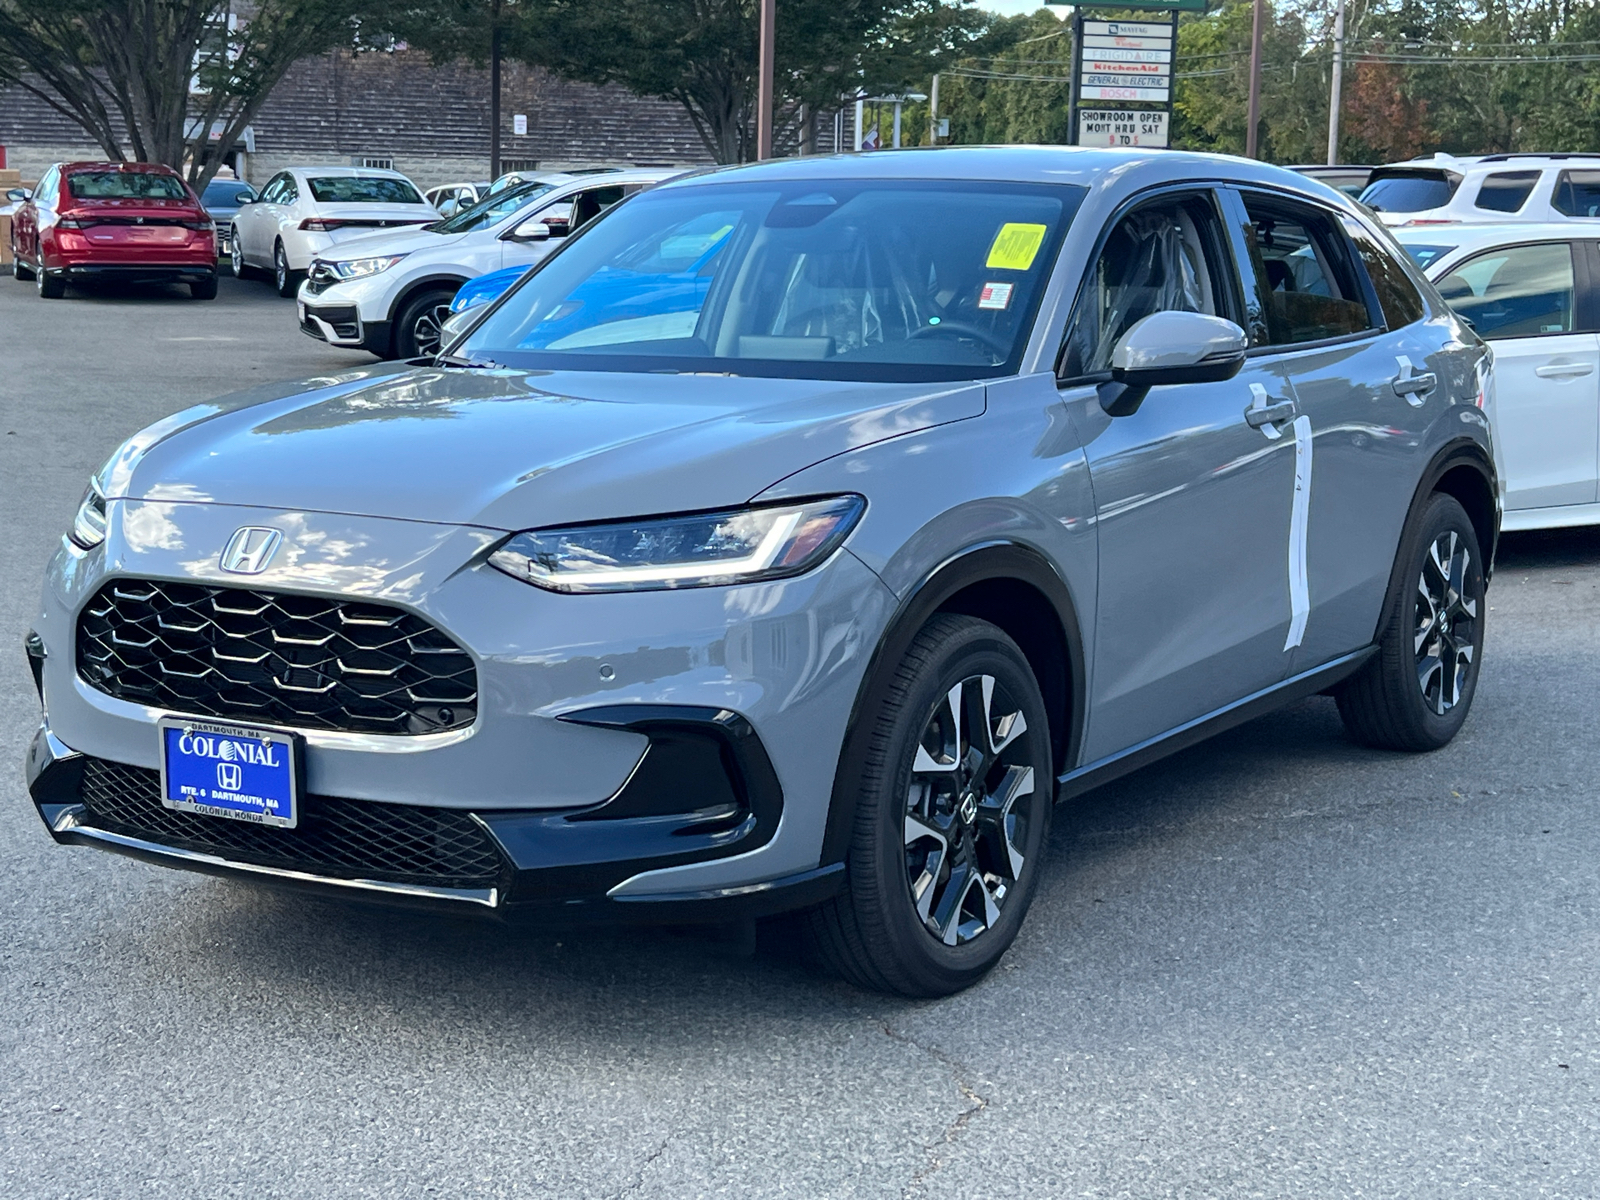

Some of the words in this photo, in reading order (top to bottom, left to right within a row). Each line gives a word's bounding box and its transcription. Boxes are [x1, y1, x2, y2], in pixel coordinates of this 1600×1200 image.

[1120, 26, 1148, 34] MAYTAG
[1092, 50, 1162, 61] FRIGIDAIRE
[1094, 63, 1159, 72] KitchenAid
[1088, 75, 1120, 85] GENERAL
[1129, 77, 1164, 86] ELECTRIC
[1100, 88, 1137, 98] BOSCH
[1082, 112, 1134, 122] SHOWROOM
[1140, 113, 1163, 122] OPEN
[1142, 124, 1159, 134] SAT
[1109, 135, 1115, 145] 9
[1120, 135, 1130, 145] TO
[1133, 135, 1139, 145] 5
[179, 735, 279, 768] COLONIAL
[181, 785, 199, 797] RTE.
[200, 788, 206, 797] 6
[211, 790, 265, 807] DARTMOUTH,
[266, 798, 279, 808] MA
[194, 804, 233, 818] COLONIAL
[234, 811, 264, 822] HONDA
